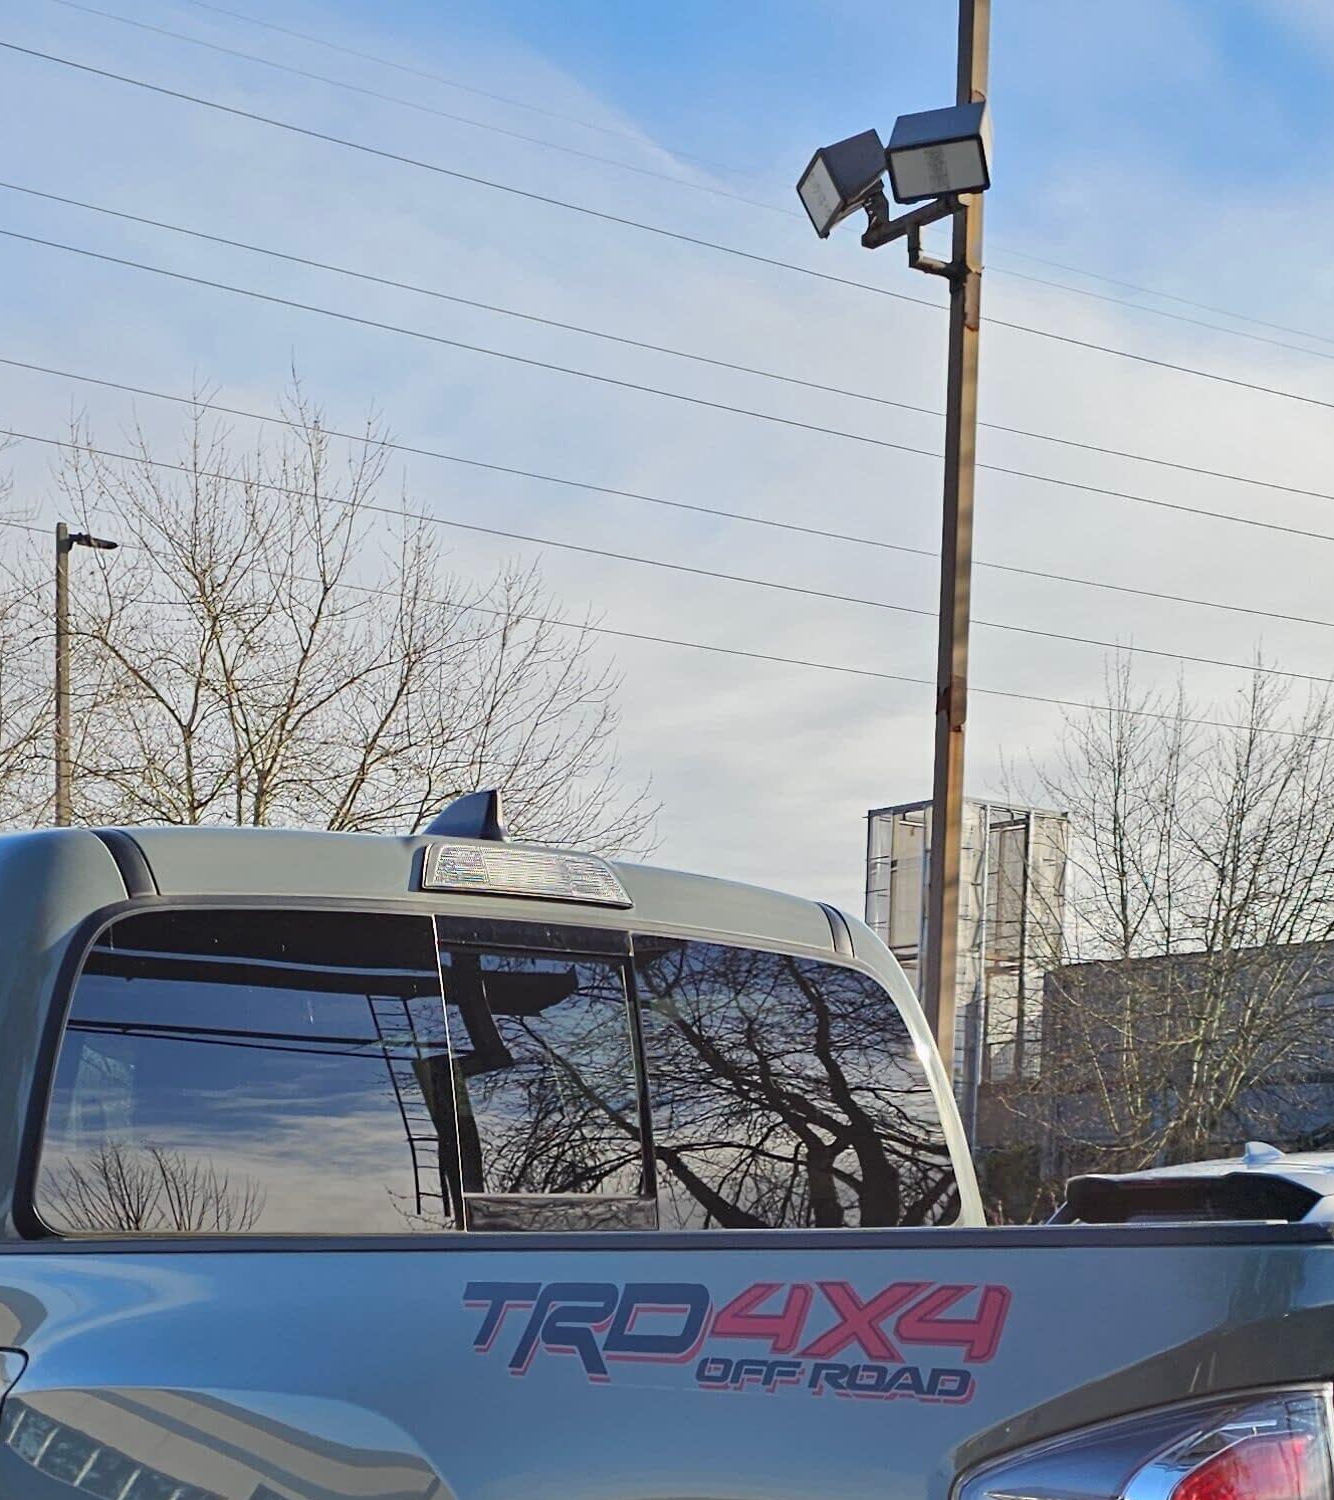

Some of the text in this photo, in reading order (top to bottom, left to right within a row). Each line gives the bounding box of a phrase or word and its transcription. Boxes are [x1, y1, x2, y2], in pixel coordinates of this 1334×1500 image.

[463, 1280, 714, 1384] TRD
[695, 1356, 976, 1406] OFF ROAD
